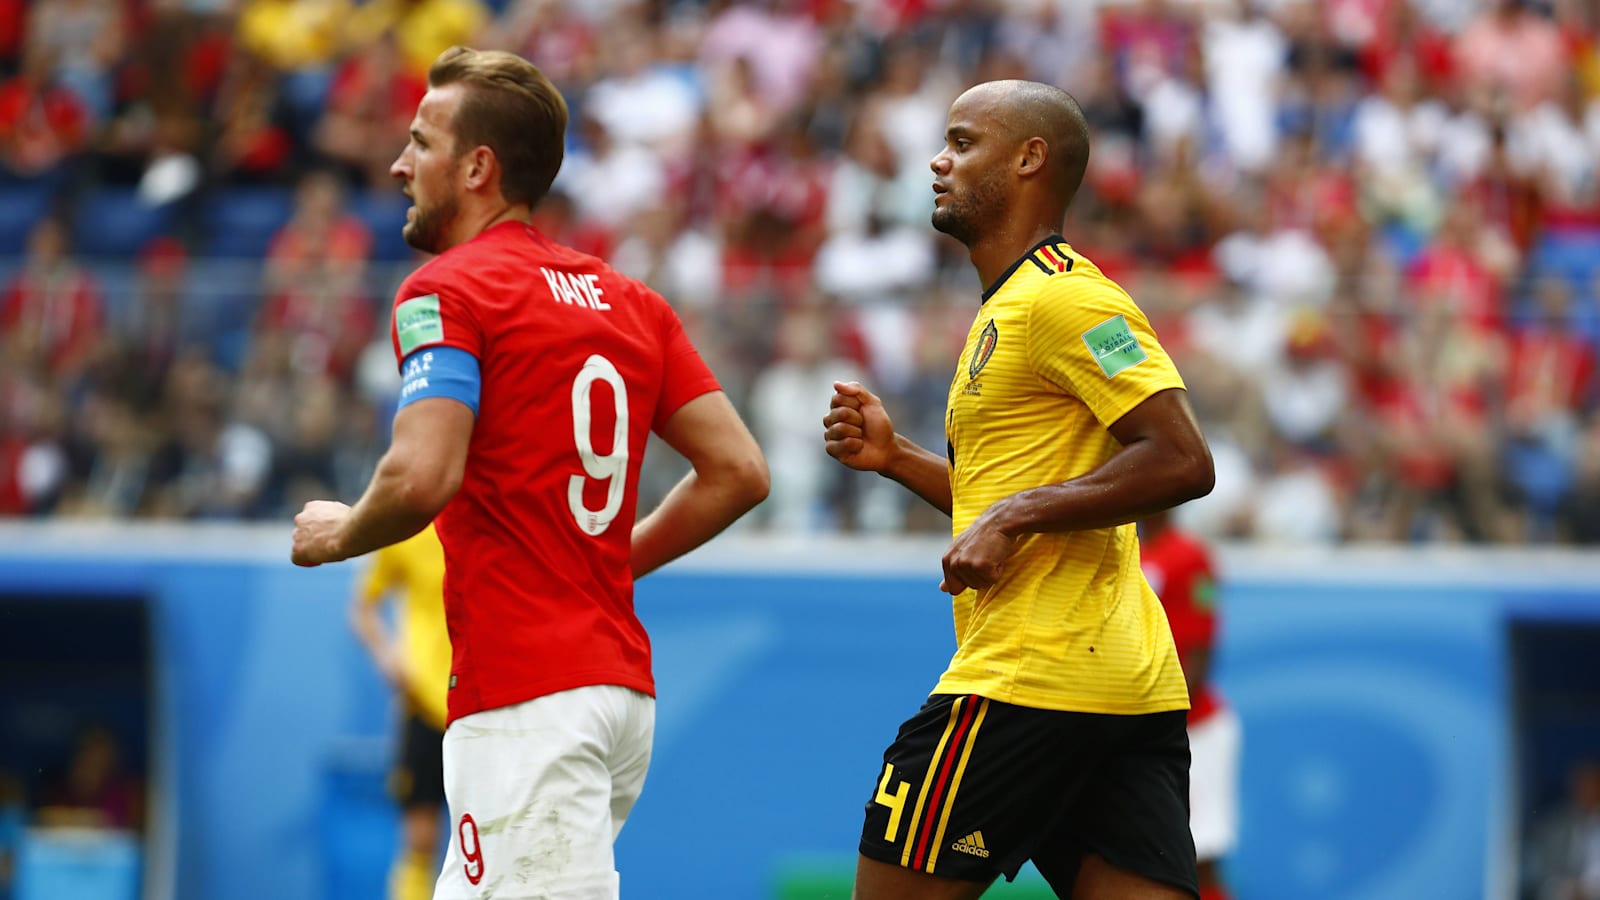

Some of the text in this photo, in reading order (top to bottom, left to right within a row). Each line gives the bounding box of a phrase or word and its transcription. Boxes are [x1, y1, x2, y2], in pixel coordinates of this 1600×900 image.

[540, 267, 611, 310] KANE
[402, 377, 429, 398] FIFA
[567, 354, 629, 536] 9
[875, 762, 911, 843] 4
[458, 813, 484, 886] 9
[952, 842, 990, 858] adidas
